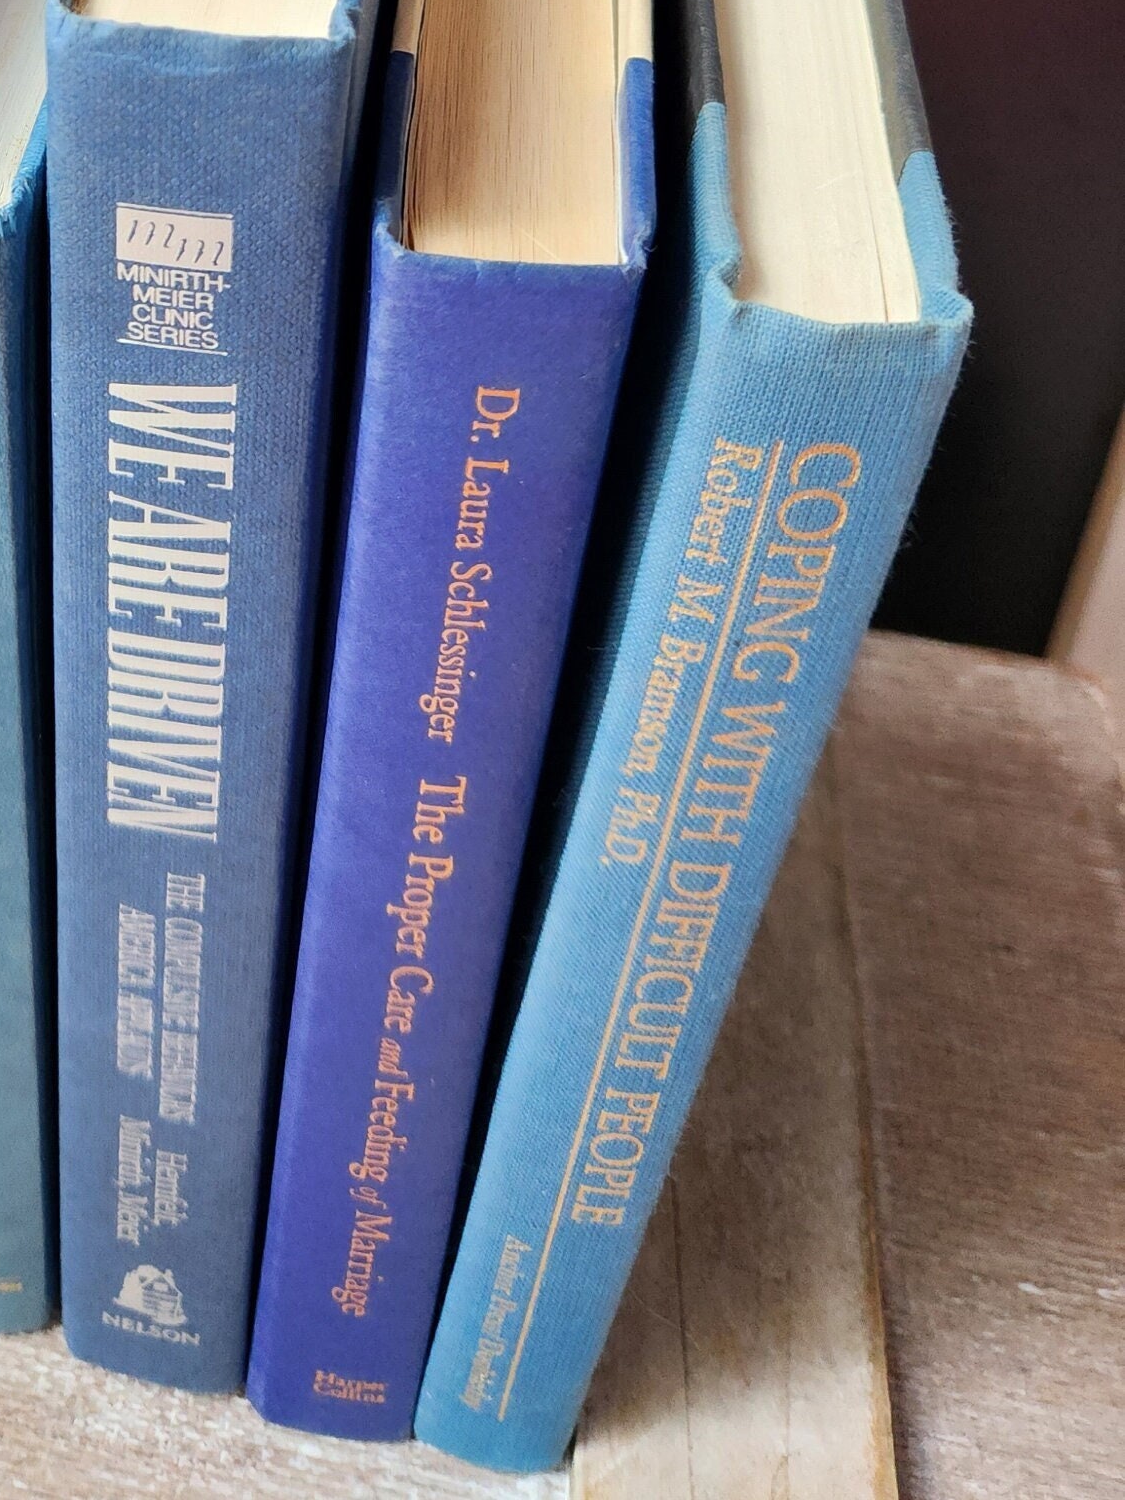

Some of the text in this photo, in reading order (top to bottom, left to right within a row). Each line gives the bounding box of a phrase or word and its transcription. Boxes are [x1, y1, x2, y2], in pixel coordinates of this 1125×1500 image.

[117, 262, 231, 292] MINIRTH-
[133, 284, 214, 311] MEIER
[127, 321, 219, 350] SERIES
[132, 304, 213, 330] CLINIC
[420, 385, 520, 746] Dr. Laura Schlessinger
[107, 383, 237, 843] WE ARE DRIVEN
[600, 438, 762, 867] Robert M. Bramson, Ph.D.
[571, 443, 862, 1225] COPING WITH DIFFICULT PEOPLE
[167, 872, 204, 910] THE
[331, 775, 466, 1317] The Proper Care and Feeding of Marriage
[102, 1311, 200, 1346] NELSON
